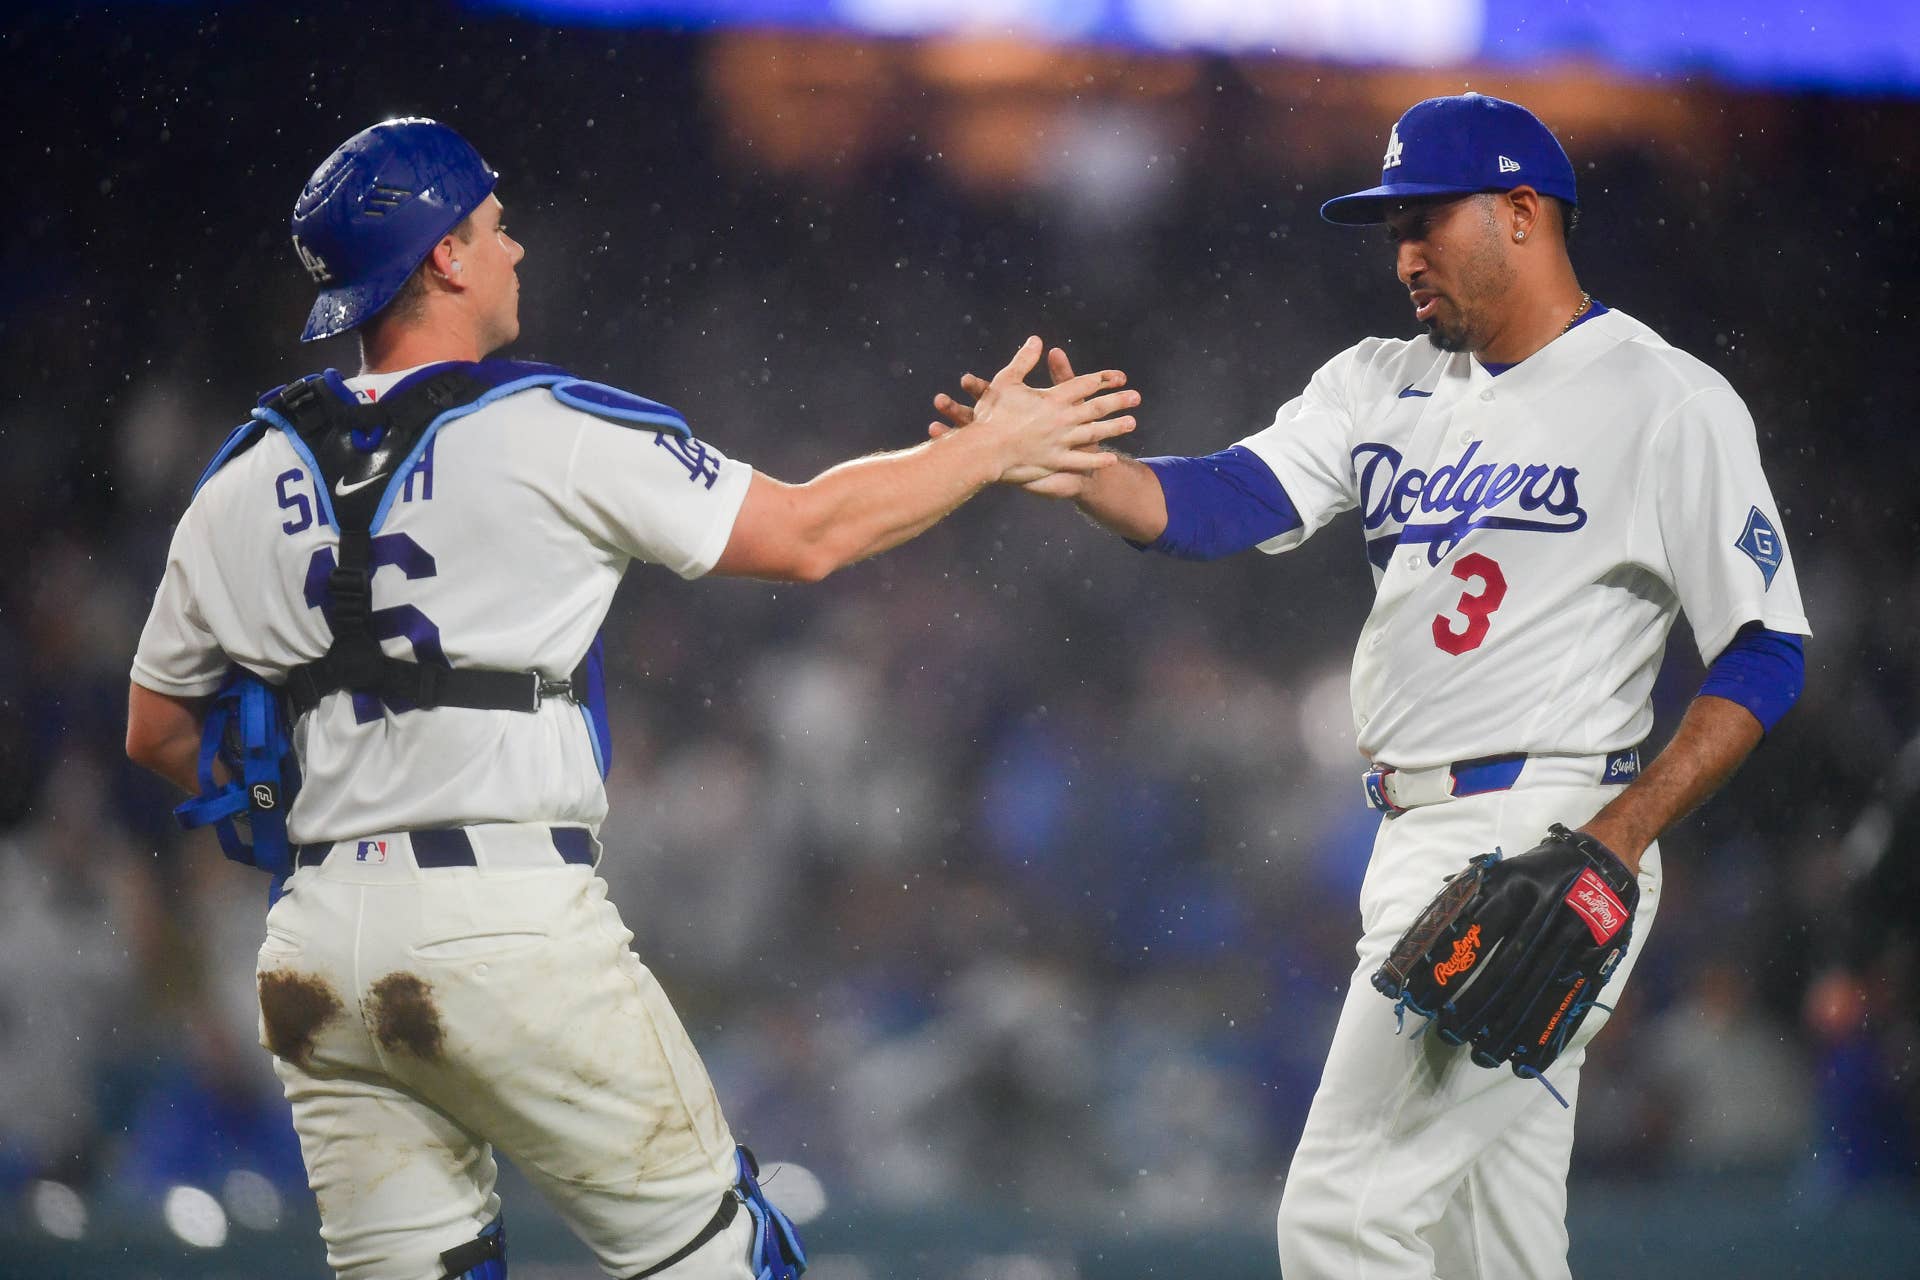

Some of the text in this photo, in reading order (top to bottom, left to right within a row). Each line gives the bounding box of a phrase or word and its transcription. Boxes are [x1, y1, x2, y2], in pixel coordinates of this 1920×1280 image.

[1351, 440, 1587, 568] Dodgers
[1753, 528, 1774, 555] G
[1432, 552, 1508, 657] 3
[1577, 890, 1618, 929] Rawlings
[1434, 924, 1482, 986] Rawlings
